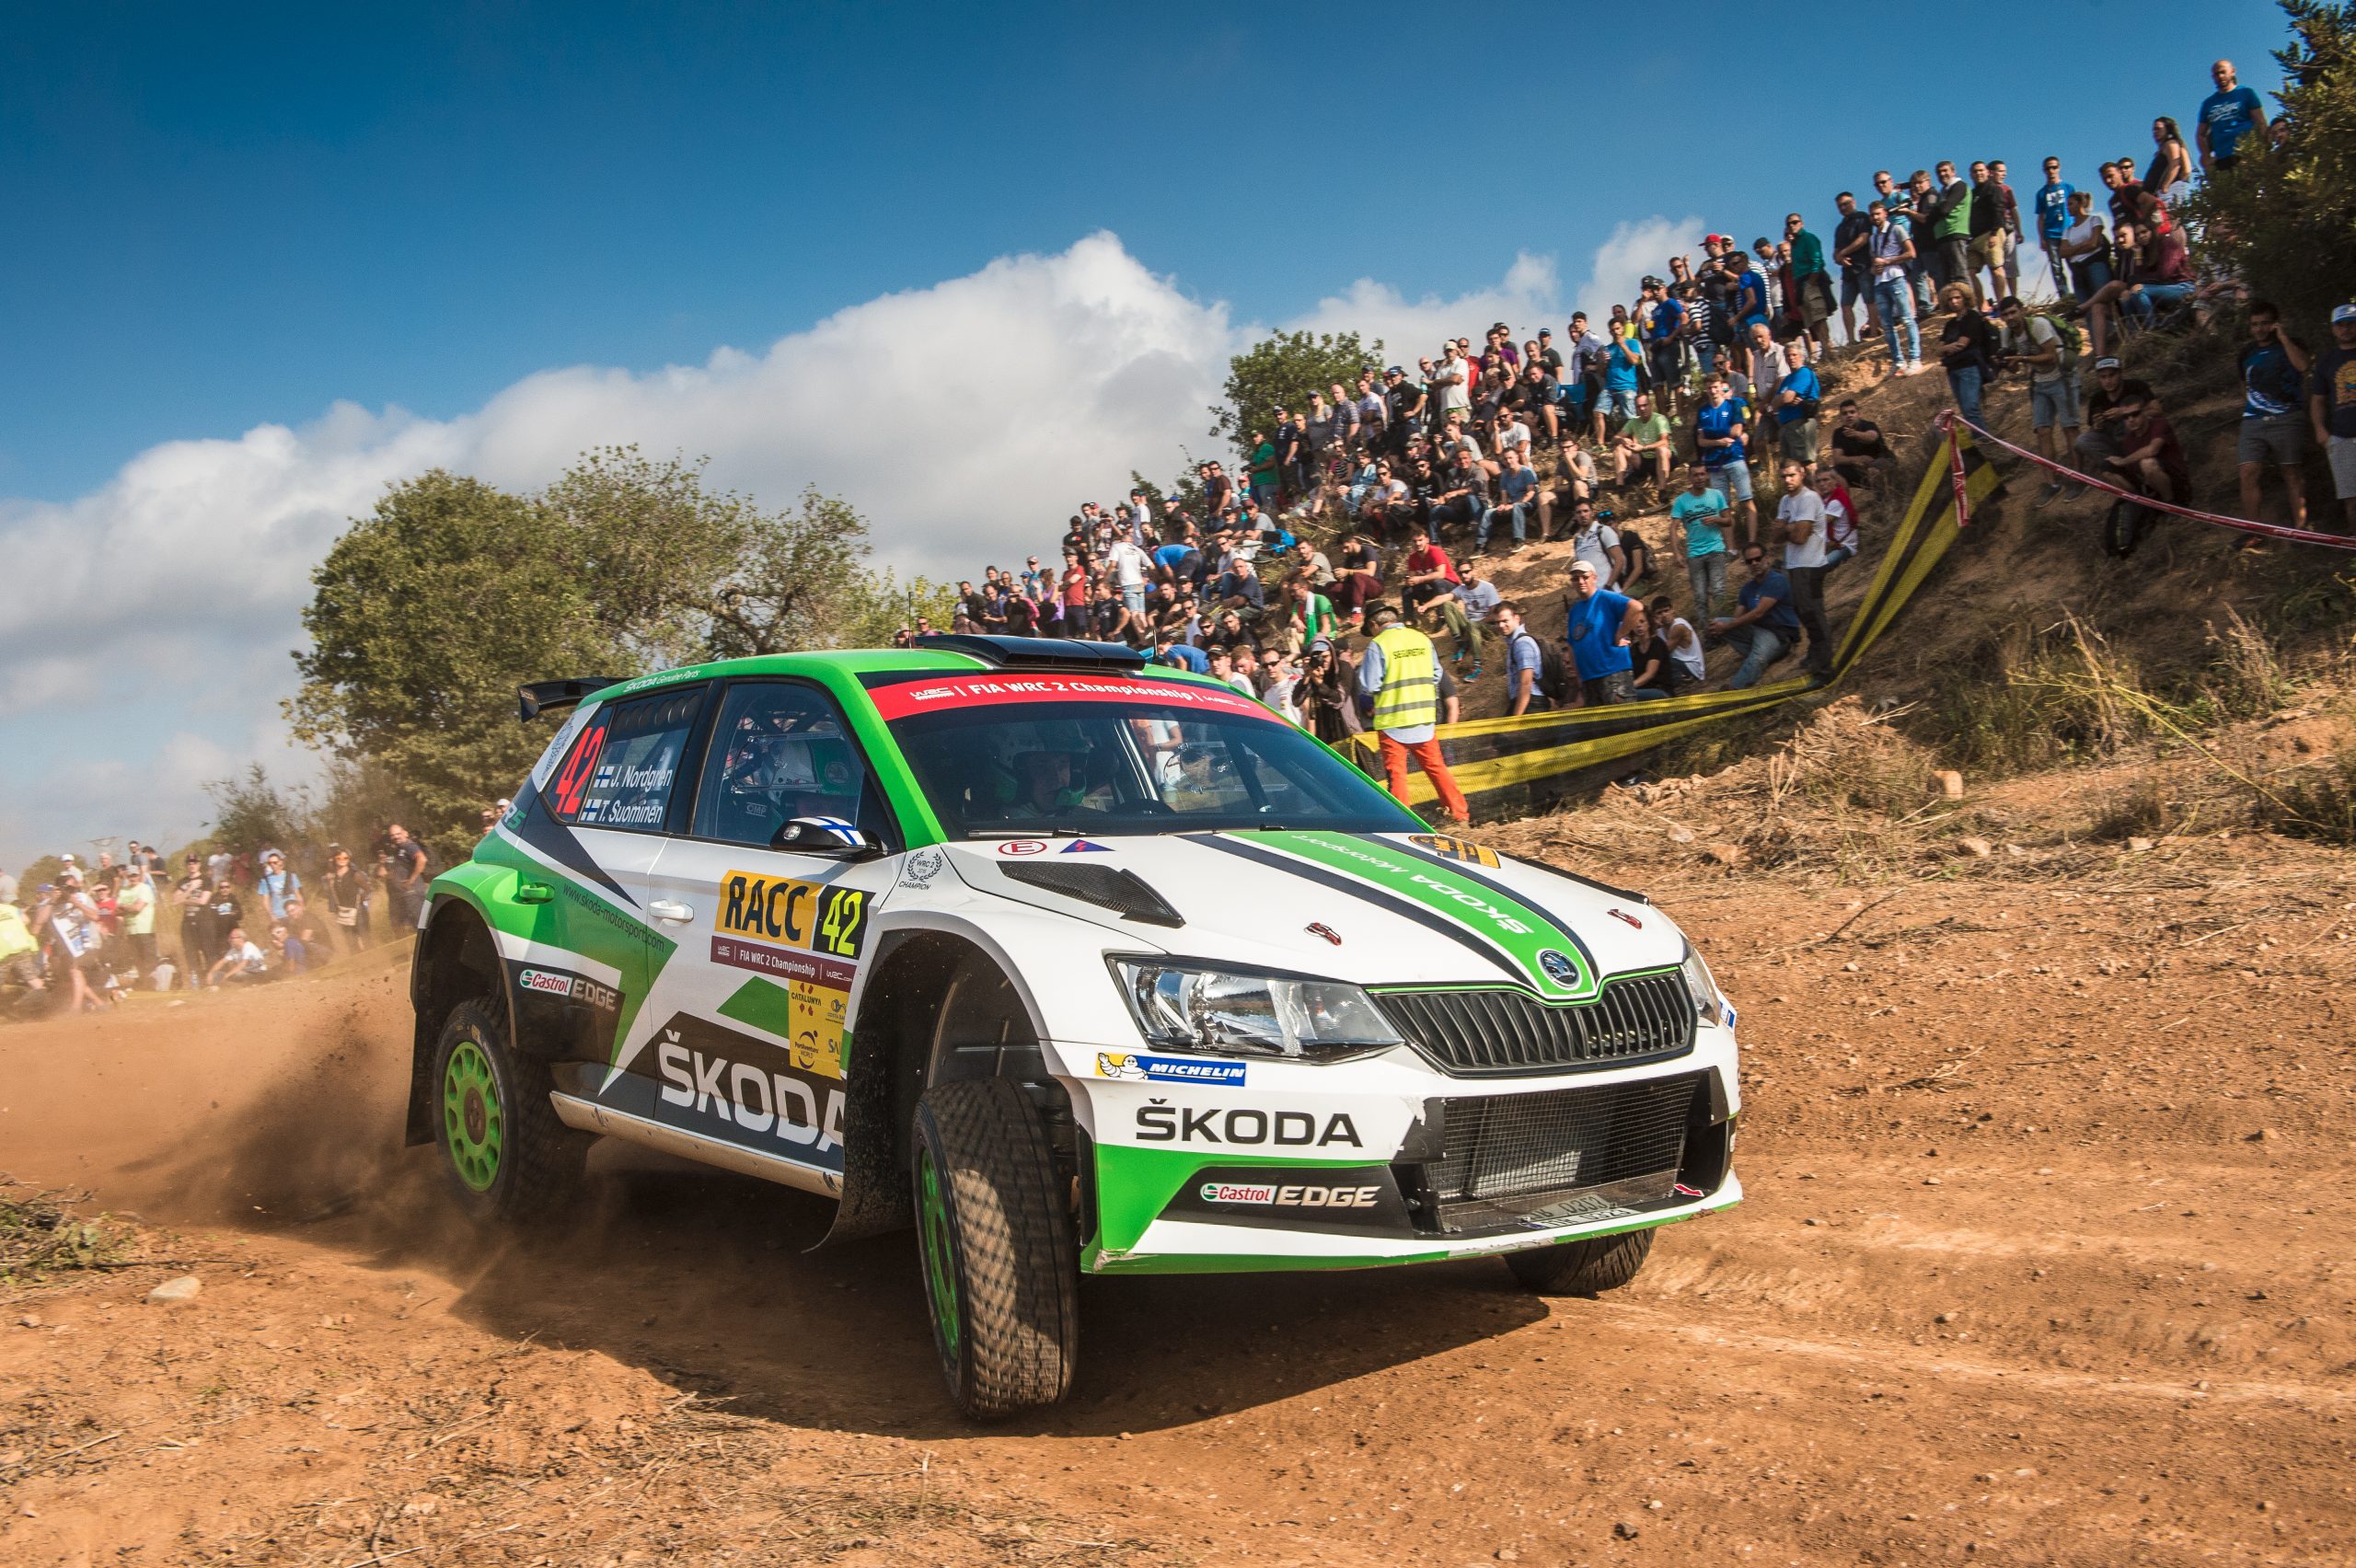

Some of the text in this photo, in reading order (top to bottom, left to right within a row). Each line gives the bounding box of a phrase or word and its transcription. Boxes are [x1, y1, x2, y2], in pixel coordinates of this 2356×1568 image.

[967, 682, 1006, 695] FIA
[1006, 682, 1051, 693] WRC
[1051, 682, 1069, 692] 2
[1070, 682, 1194, 701] Championship
[555, 725, 606, 814] 42
[610, 765, 674, 792] J. Nordgren
[598, 800, 664, 824] T. Suominen
[917, 859, 930, 868] WRC
[1290, 835, 1410, 874] Motorsport
[898, 881, 932, 890] CHAMPION
[563, 882, 664, 952] www.skoda-motorsport.com
[724, 875, 809, 942] RACC
[822, 889, 863, 957] 42
[740, 950, 750, 962] FIA
[751, 951, 765, 965] WRC
[766, 955, 770, 966] 2
[771, 956, 815, 976] Championship
[532, 973, 569, 993] Castrol
[571, 978, 618, 1011] EDGE
[791, 992, 822, 1006] CATALUNYA
[1149, 1063, 1244, 1078] MICHELIN
[659, 1029, 846, 1153] ŠKODA
[1136, 1098, 1363, 1147] ŠKODA
[1218, 1186, 1272, 1202] Castrol
[1275, 1185, 1381, 1207] EDGE
